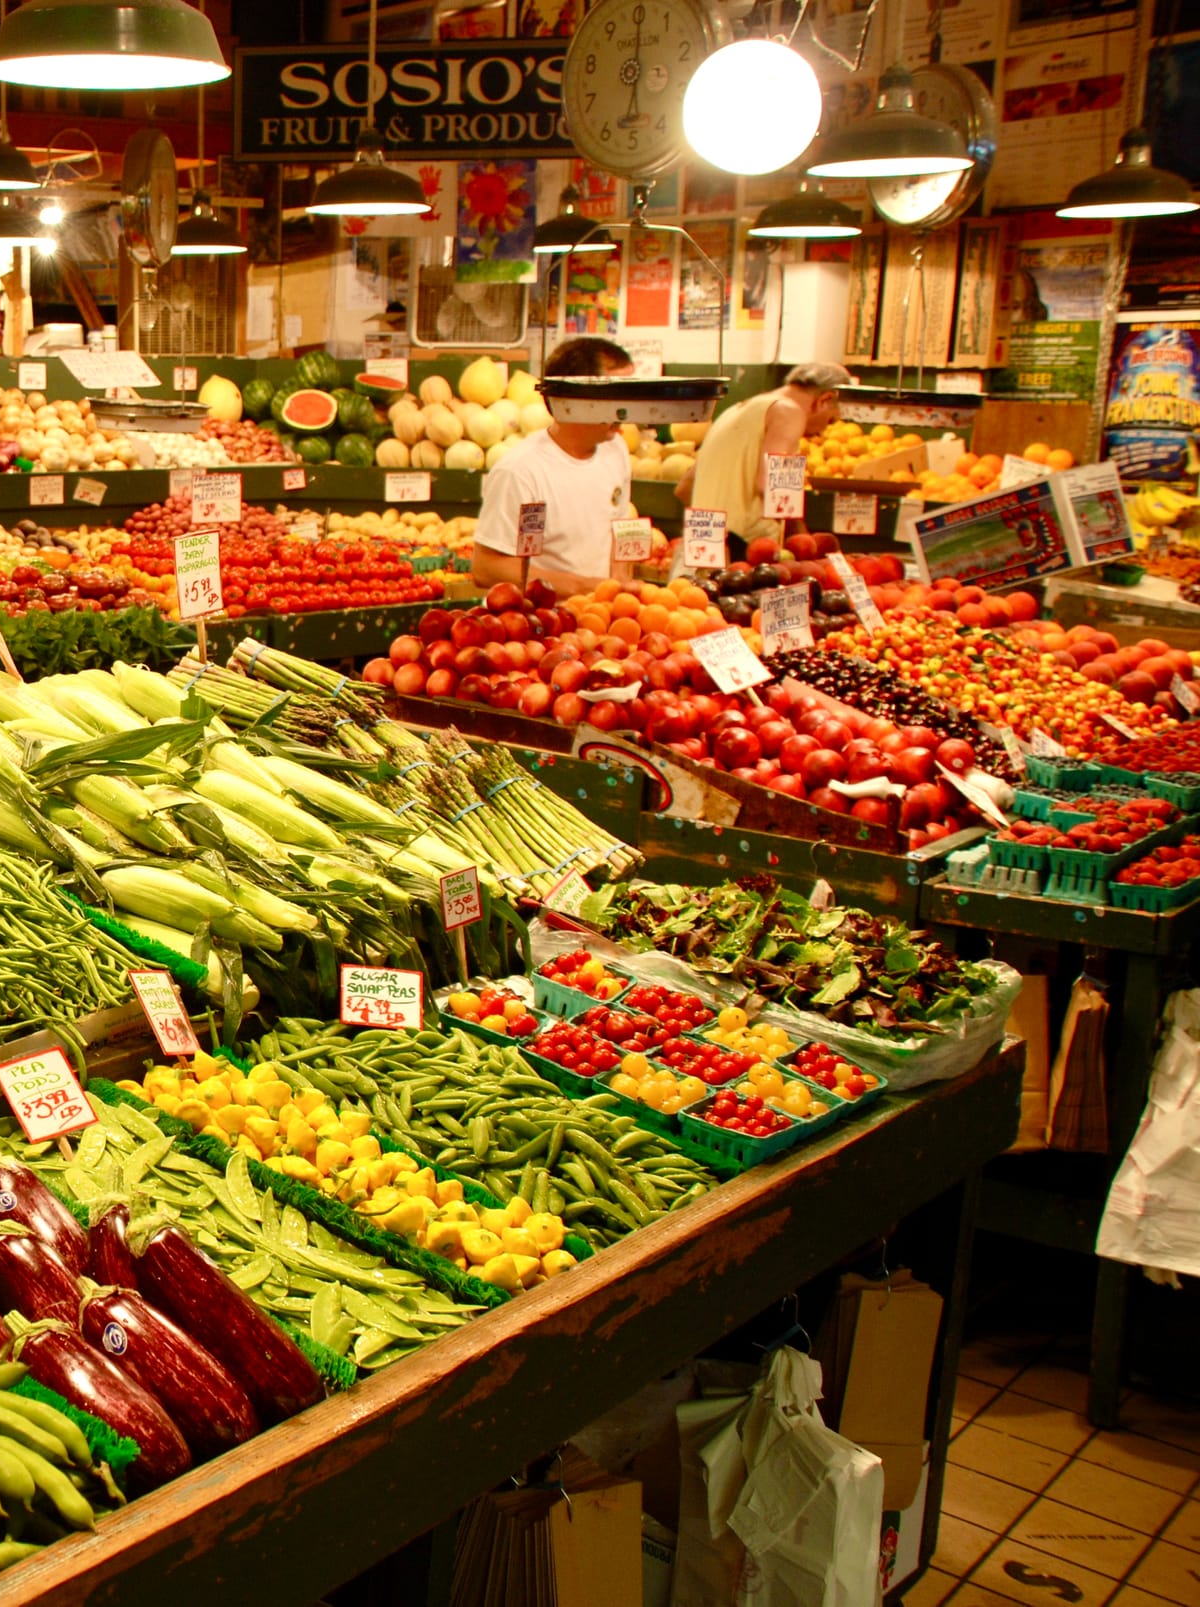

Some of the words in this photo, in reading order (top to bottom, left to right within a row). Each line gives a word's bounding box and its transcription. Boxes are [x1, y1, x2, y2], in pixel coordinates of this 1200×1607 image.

[633, 5, 645, 25] 0
[664, 11, 670, 32] 1
[605, 21, 616, 41] 9
[679, 41, 690, 62] 2
[585, 54, 596, 74] 8
[280, 54, 566, 109] SOSIO'S
[585, 93, 596, 113] 7
[385, 114, 415, 142] &
[422, 111, 575, 142] PRODUC
[601, 121, 611, 141] 6
[655, 114, 666, 133] 4
[627, 130, 638, 150] 5
[180, 535, 212, 549] TENDER
[350, 970, 398, 985] SUGAR
[347, 982, 385, 994] SNAP
[387, 985, 416, 998] PEAS
[6, 1060, 45, 1077] PEA
[8, 1072, 61, 1093] PODS
